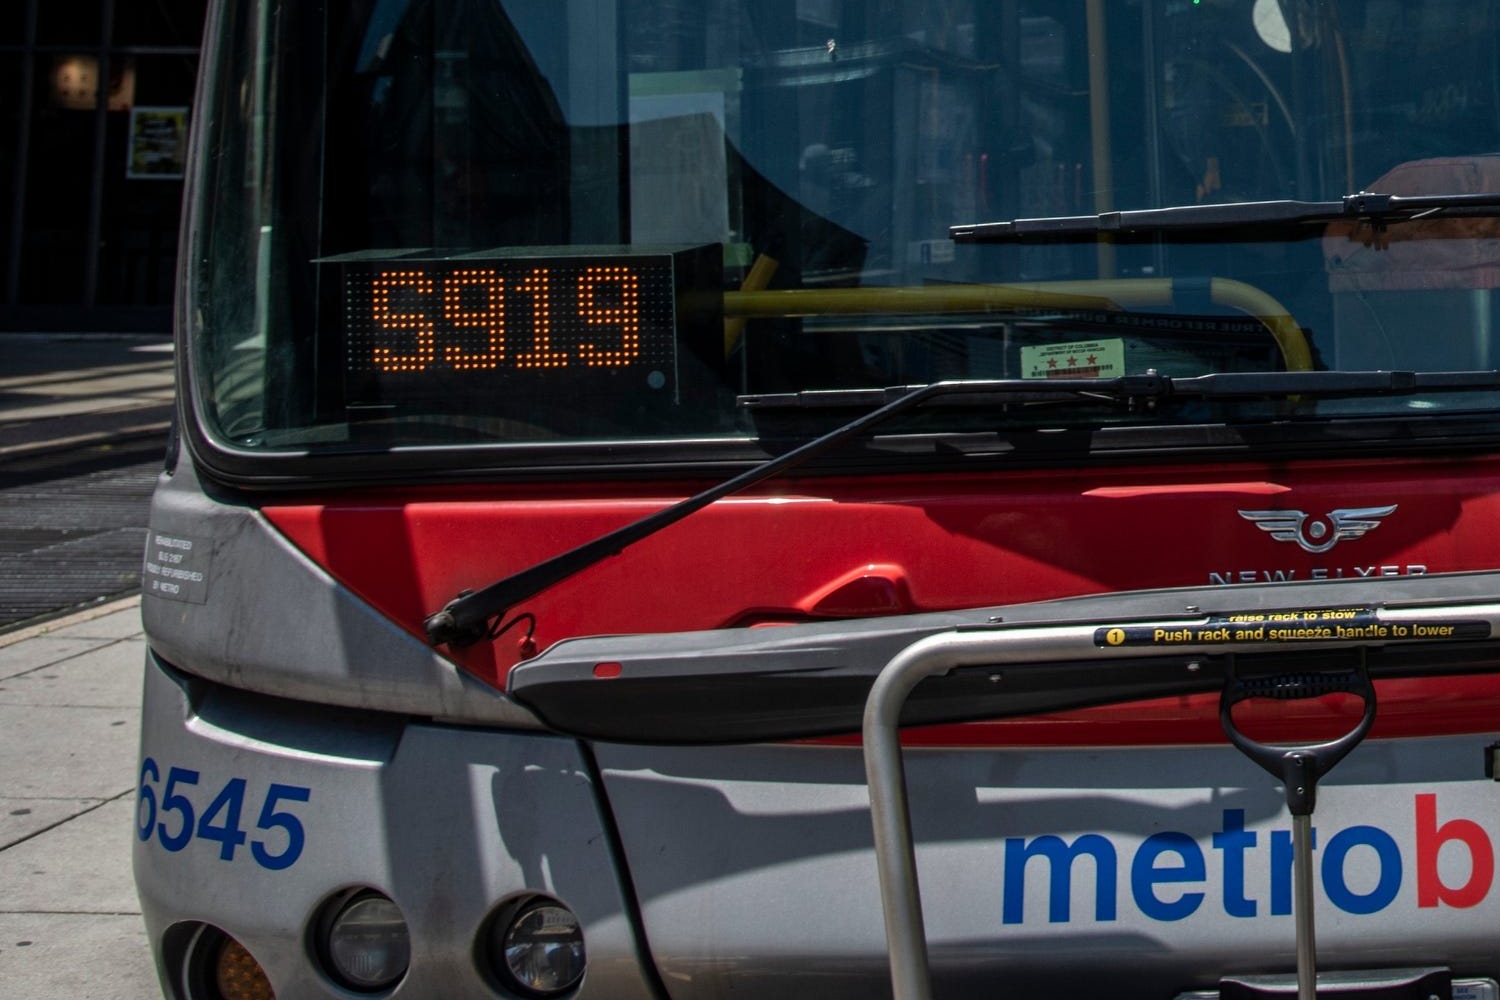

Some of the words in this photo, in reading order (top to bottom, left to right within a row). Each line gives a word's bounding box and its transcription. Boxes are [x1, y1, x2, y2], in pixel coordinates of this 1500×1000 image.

[1209, 569, 1296, 585] NEW
[1229, 613, 1265, 622] raise
[1268, 611, 1299, 621] rack
[1303, 611, 1318, 620] to
[1322, 610, 1356, 620] stow
[1154, 629, 1193, 642] Push
[1198, 628, 1230, 641] rack
[1235, 627, 1263, 640] and
[1268, 626, 1332, 642] squeeze
[1336, 625, 1387, 638] handle
[1392, 625, 1408, 637] to
[1413, 623, 1455, 637] lower
[137, 756, 312, 872] 6545
